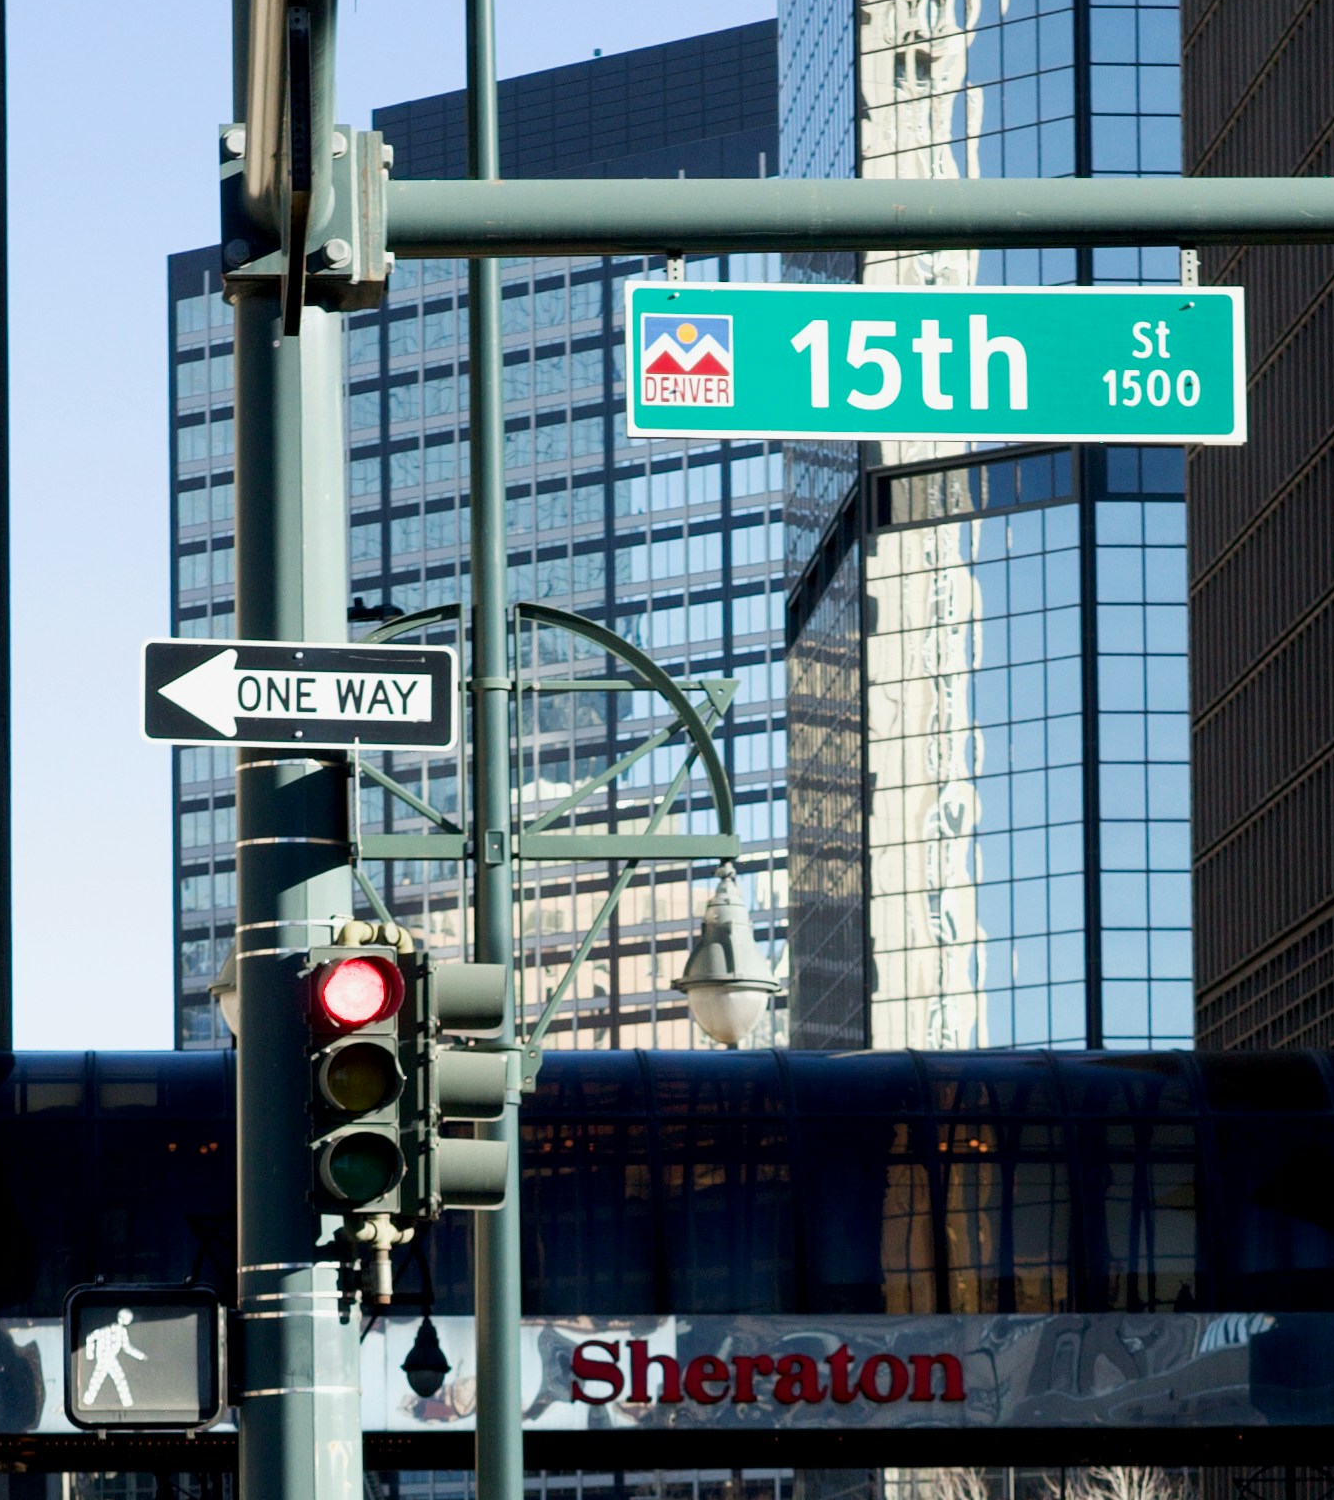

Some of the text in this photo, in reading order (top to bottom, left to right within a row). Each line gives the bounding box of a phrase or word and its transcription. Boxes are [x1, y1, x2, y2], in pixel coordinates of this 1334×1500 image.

[790, 313, 1029, 410] 15th
[1130, 320, 1172, 362] St
[644, 376, 730, 405] DENVER
[1103, 367, 1202, 410] 1500
[237, 675, 420, 716] ONE WAY
[570, 1339, 967, 1406] Sheraton
